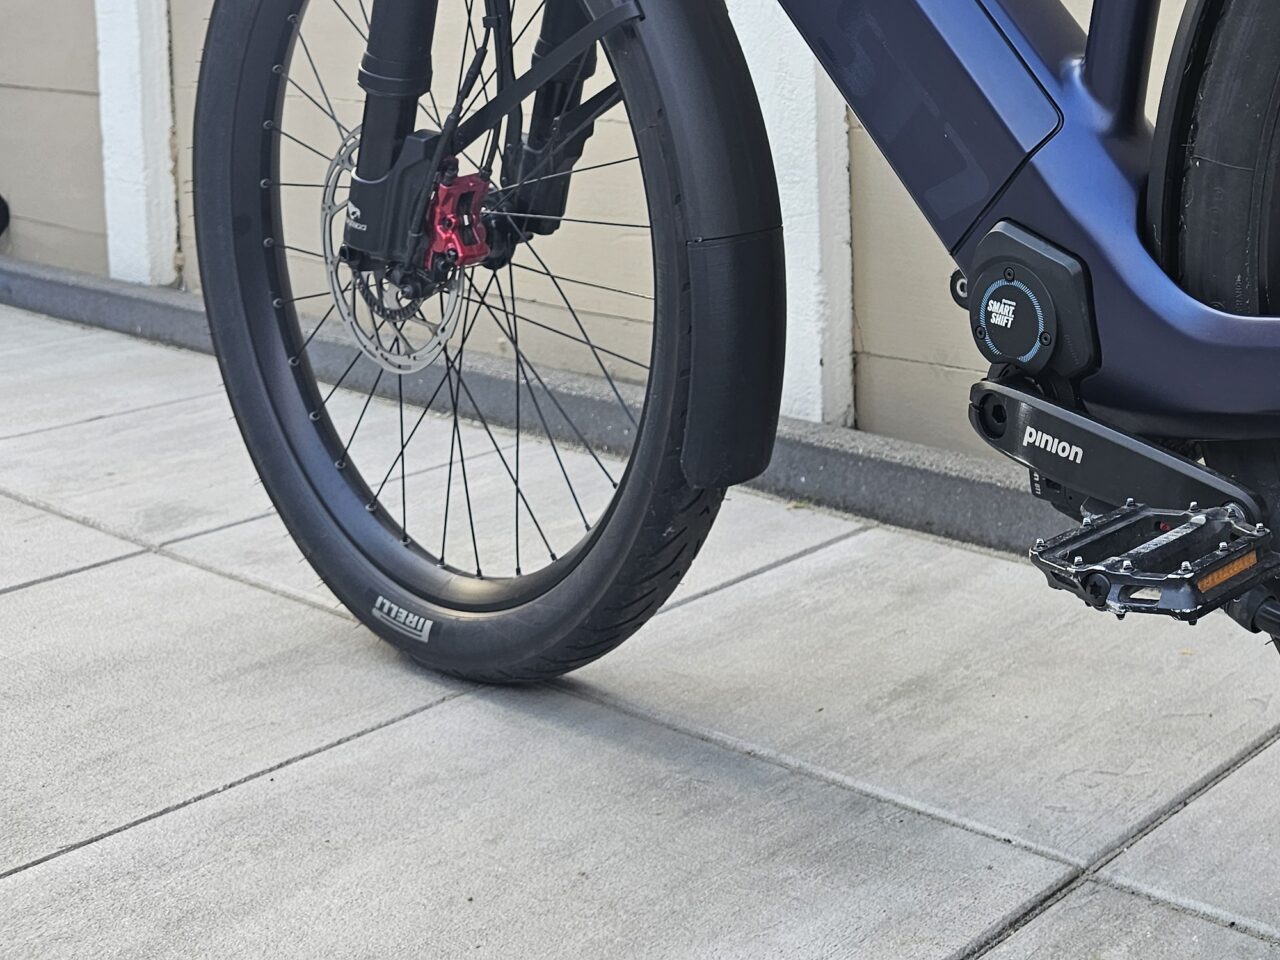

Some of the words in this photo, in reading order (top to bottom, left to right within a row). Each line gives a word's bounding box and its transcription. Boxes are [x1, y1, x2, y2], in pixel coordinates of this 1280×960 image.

[990, 313, 1014, 329] SHIFT
[1022, 425, 1084, 464] pinion
[371, 595, 434, 644] PIRELLI
